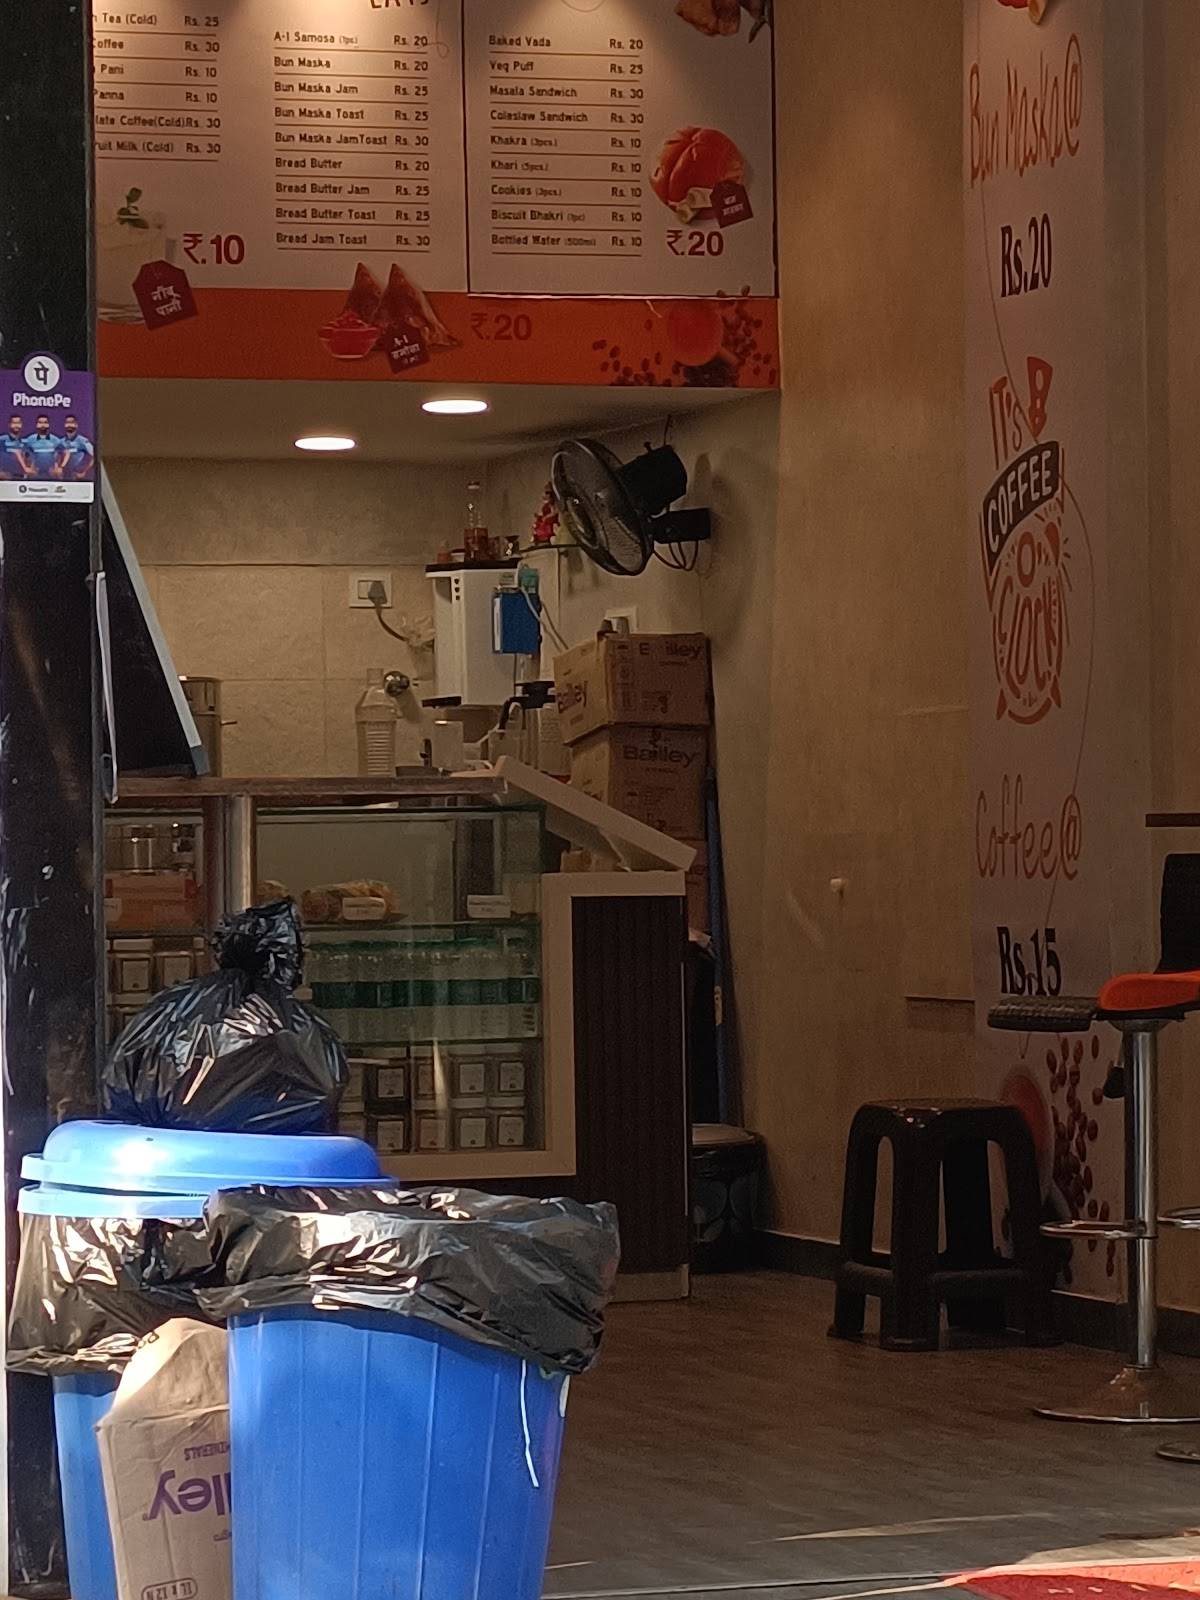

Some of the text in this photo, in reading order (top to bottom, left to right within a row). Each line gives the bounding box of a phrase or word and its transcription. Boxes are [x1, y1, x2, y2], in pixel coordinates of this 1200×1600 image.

[102, 13, 121, 23] Tea
[126, 14, 157, 25] (Cold)
[204, 16, 219, 27] 25
[294, 32, 335, 43] Samosa
[414, 36, 428, 46] 20
[489, 35, 521, 46] Baked
[525, 37, 551, 47] Vada
[630, 39, 643, 49] 20
[205, 41, 220, 52] 30
[101, 64, 124, 74] Pani
[205, 67, 217, 77] 10
[274, 56, 294, 67] Bun
[298, 57, 330, 68] Maska
[414, 61, 428, 71] 20
[513, 61, 534, 71] Puff
[630, 64, 643, 74] 25
[275, 81, 294, 92] Bun
[298, 83, 331, 93] Maska
[334, 84, 358, 94] Jam
[415, 86, 428, 96] 25
[490, 85, 524, 96] Masala
[529, 86, 577, 97] Sandwich
[630, 88, 644, 99] 30
[206, 93, 217, 103] 10
[275, 107, 295, 117] Bun
[299, 108, 331, 118] Maska
[336, 108, 364, 119] Toast
[415, 111, 428, 121] 25
[490, 110, 535, 121] Coleslaw
[540, 111, 588, 122] Sandwich
[630, 113, 644, 124] 30
[206, 118, 221, 128] 30
[969, 62, 999, 188] Bun
[275, 132, 295, 142] Bun
[299, 133, 331, 143] Maska
[415, 136, 429, 146] 30
[491, 135, 527, 145] Khakra
[631, 138, 641, 148] 10
[94, 140, 112, 151] ruit
[116, 141, 138, 151] Milk
[142, 141, 174, 152] (Cold)
[206, 143, 221, 153] 30
[275, 157, 306, 168] Bread
[310, 158, 342, 168] Butter
[415, 161, 429, 171] 20
[491, 160, 518, 170] Khari
[631, 163, 641, 173] 10
[276, 182, 306, 193] Bread
[310, 183, 343, 194] Butter
[347, 184, 370, 194] Jam
[416, 186, 430, 196] 25
[491, 184, 532, 195] Cookies
[630, 187, 642, 197] 10
[276, 208, 307, 218] Bread
[311, 208, 344, 219] Butter
[348, 209, 376, 220] Toast
[416, 211, 430, 221] 25
[491, 209, 526, 220] Biscuit
[530, 210, 563, 221] Bhakri
[631, 212, 642, 222] 10
[276, 232, 308, 243] Bread
[312, 232, 334, 244] Jam
[337, 234, 367, 244] Toast
[416, 235, 430, 246] 30
[491, 234, 529, 245] Bottled
[532, 235, 561, 245] Water
[631, 237, 642, 247] 10
[1000, 213, 1052, 297] Rs.20
[13, 393, 71, 408] PhonePe
[987, 448, 1053, 553] COFFEE
